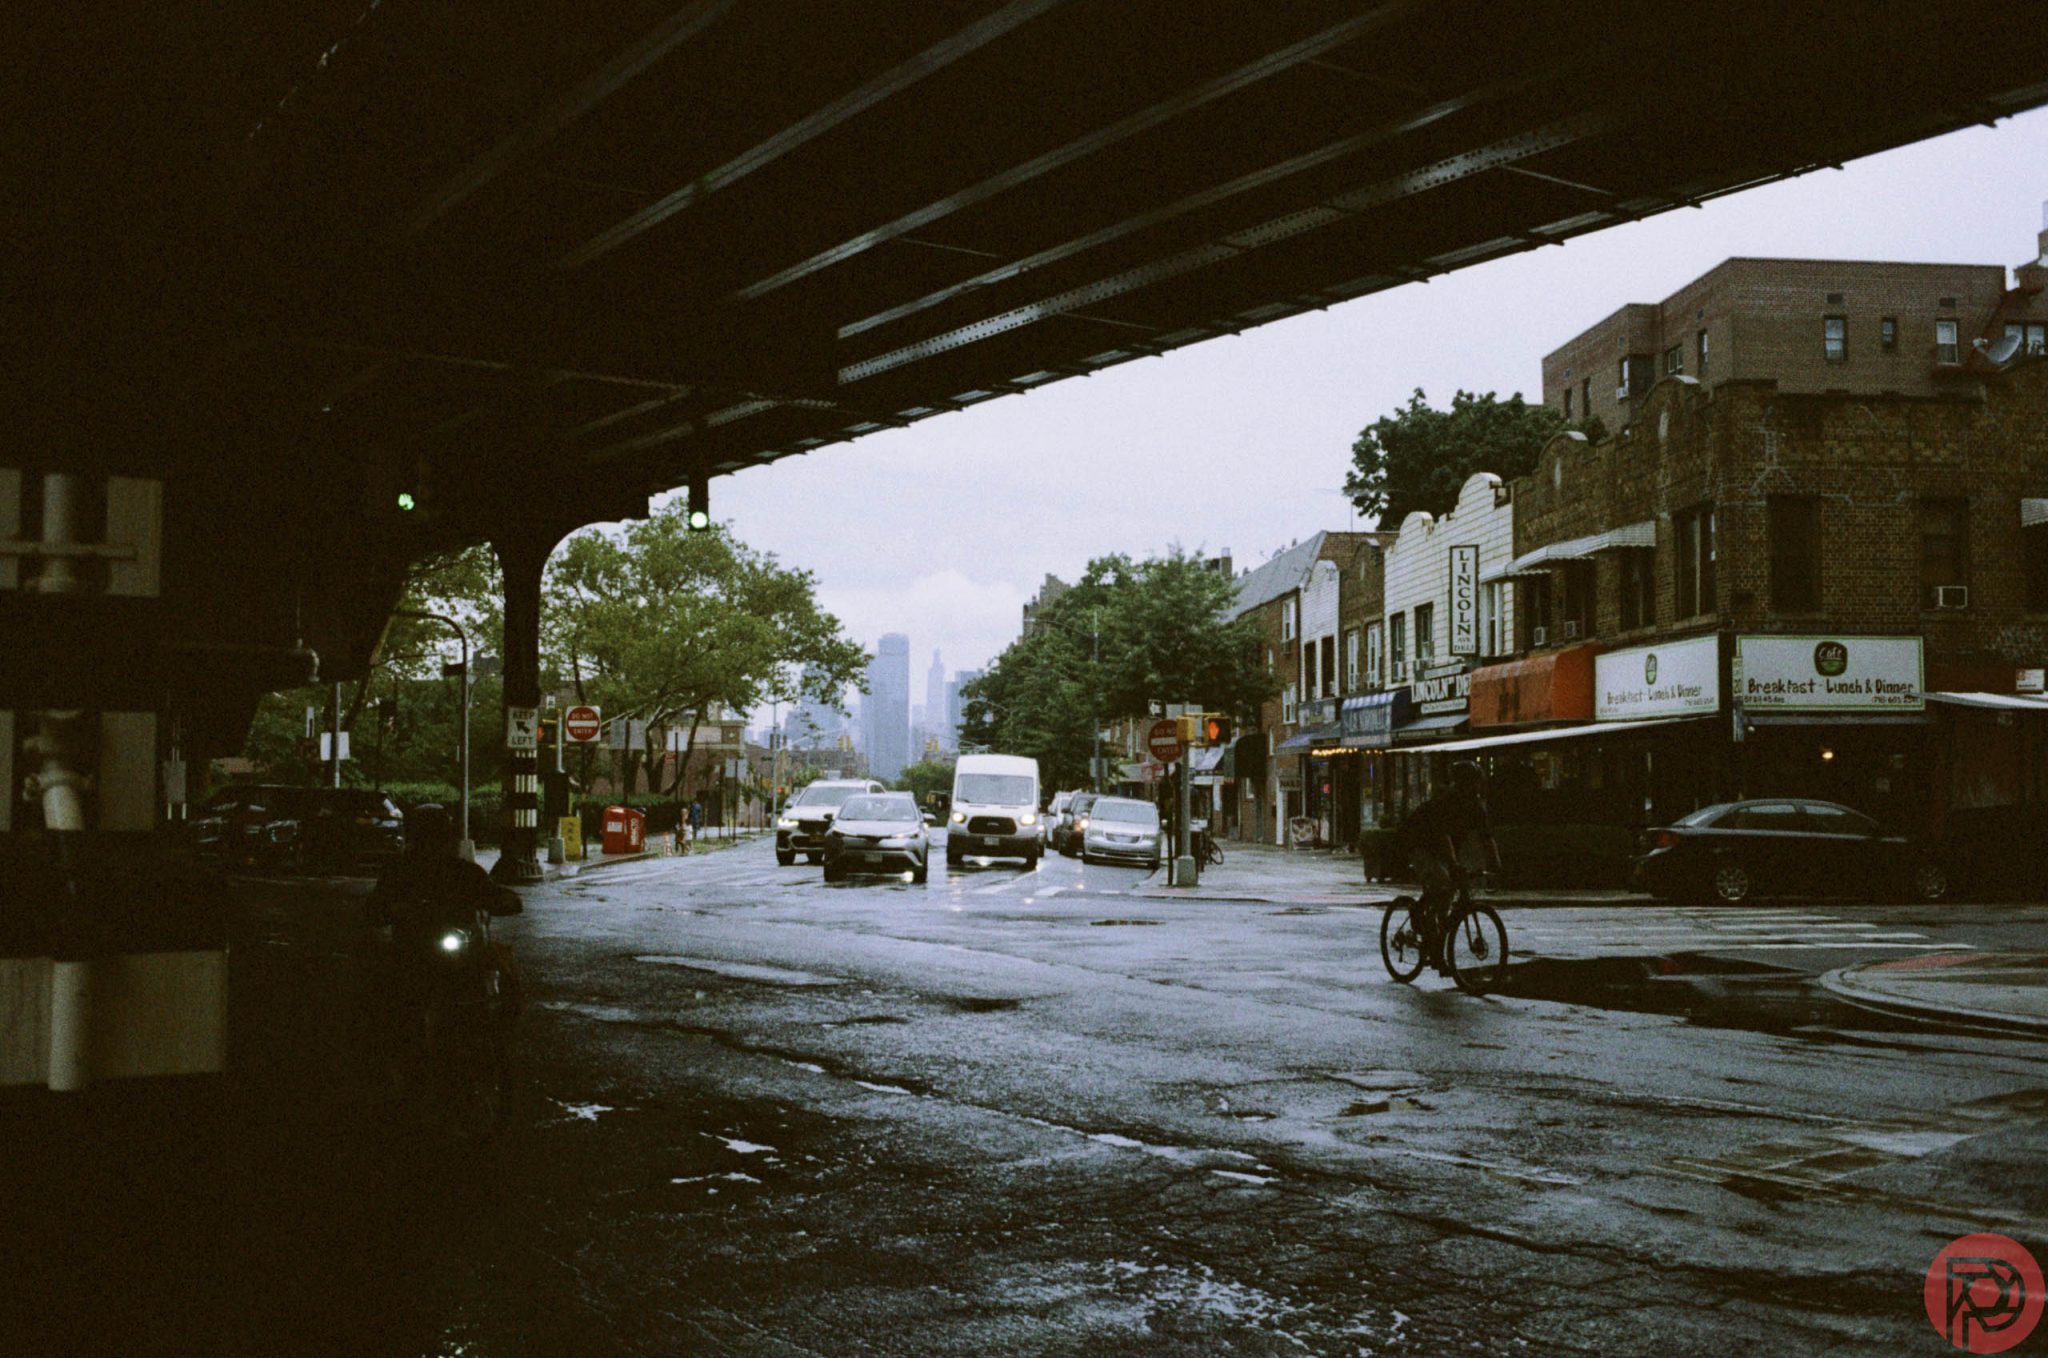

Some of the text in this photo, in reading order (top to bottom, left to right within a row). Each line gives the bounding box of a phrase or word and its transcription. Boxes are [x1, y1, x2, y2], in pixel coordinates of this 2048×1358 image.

[1457, 550, 1471, 636] LINCOLN
[1411, 672, 1472, 703] LINCOLN DE
[1748, 679, 1815, 694] Breakfast
[1826, 679, 1862, 694] Lunch
[1865, 680, 1872, 693] &
[1875, 679, 1913, 694] Dinner
[1607, 691, 1643, 705] Breakfast
[1648, 687, 1670, 700] Lunch
[1677, 684, 1702, 698] Dinner
[512, 711, 535, 719] KEEP
[573, 728, 593, 736] ENTER
[1154, 727, 1177, 737] DO NO
[512, 736, 533, 745] LEFT
